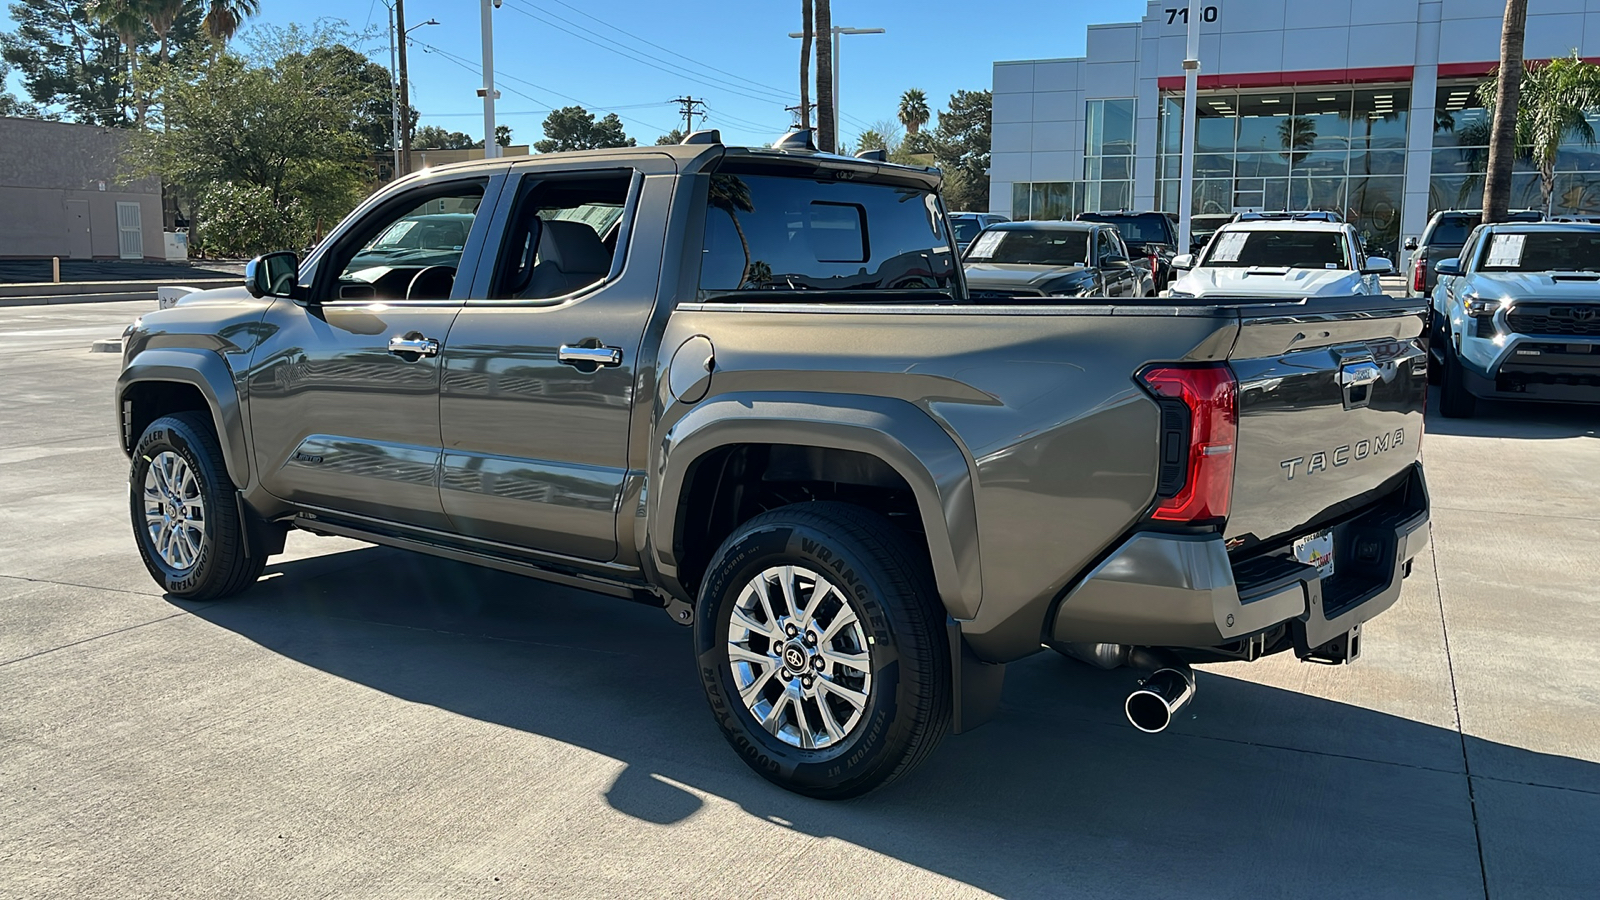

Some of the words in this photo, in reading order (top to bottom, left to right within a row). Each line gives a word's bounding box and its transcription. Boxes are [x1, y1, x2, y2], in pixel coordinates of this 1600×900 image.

[1165, 6, 1218, 25] 710
[1280, 427, 1405, 480] TACOMA
[800, 537, 889, 647] WRANGLER
